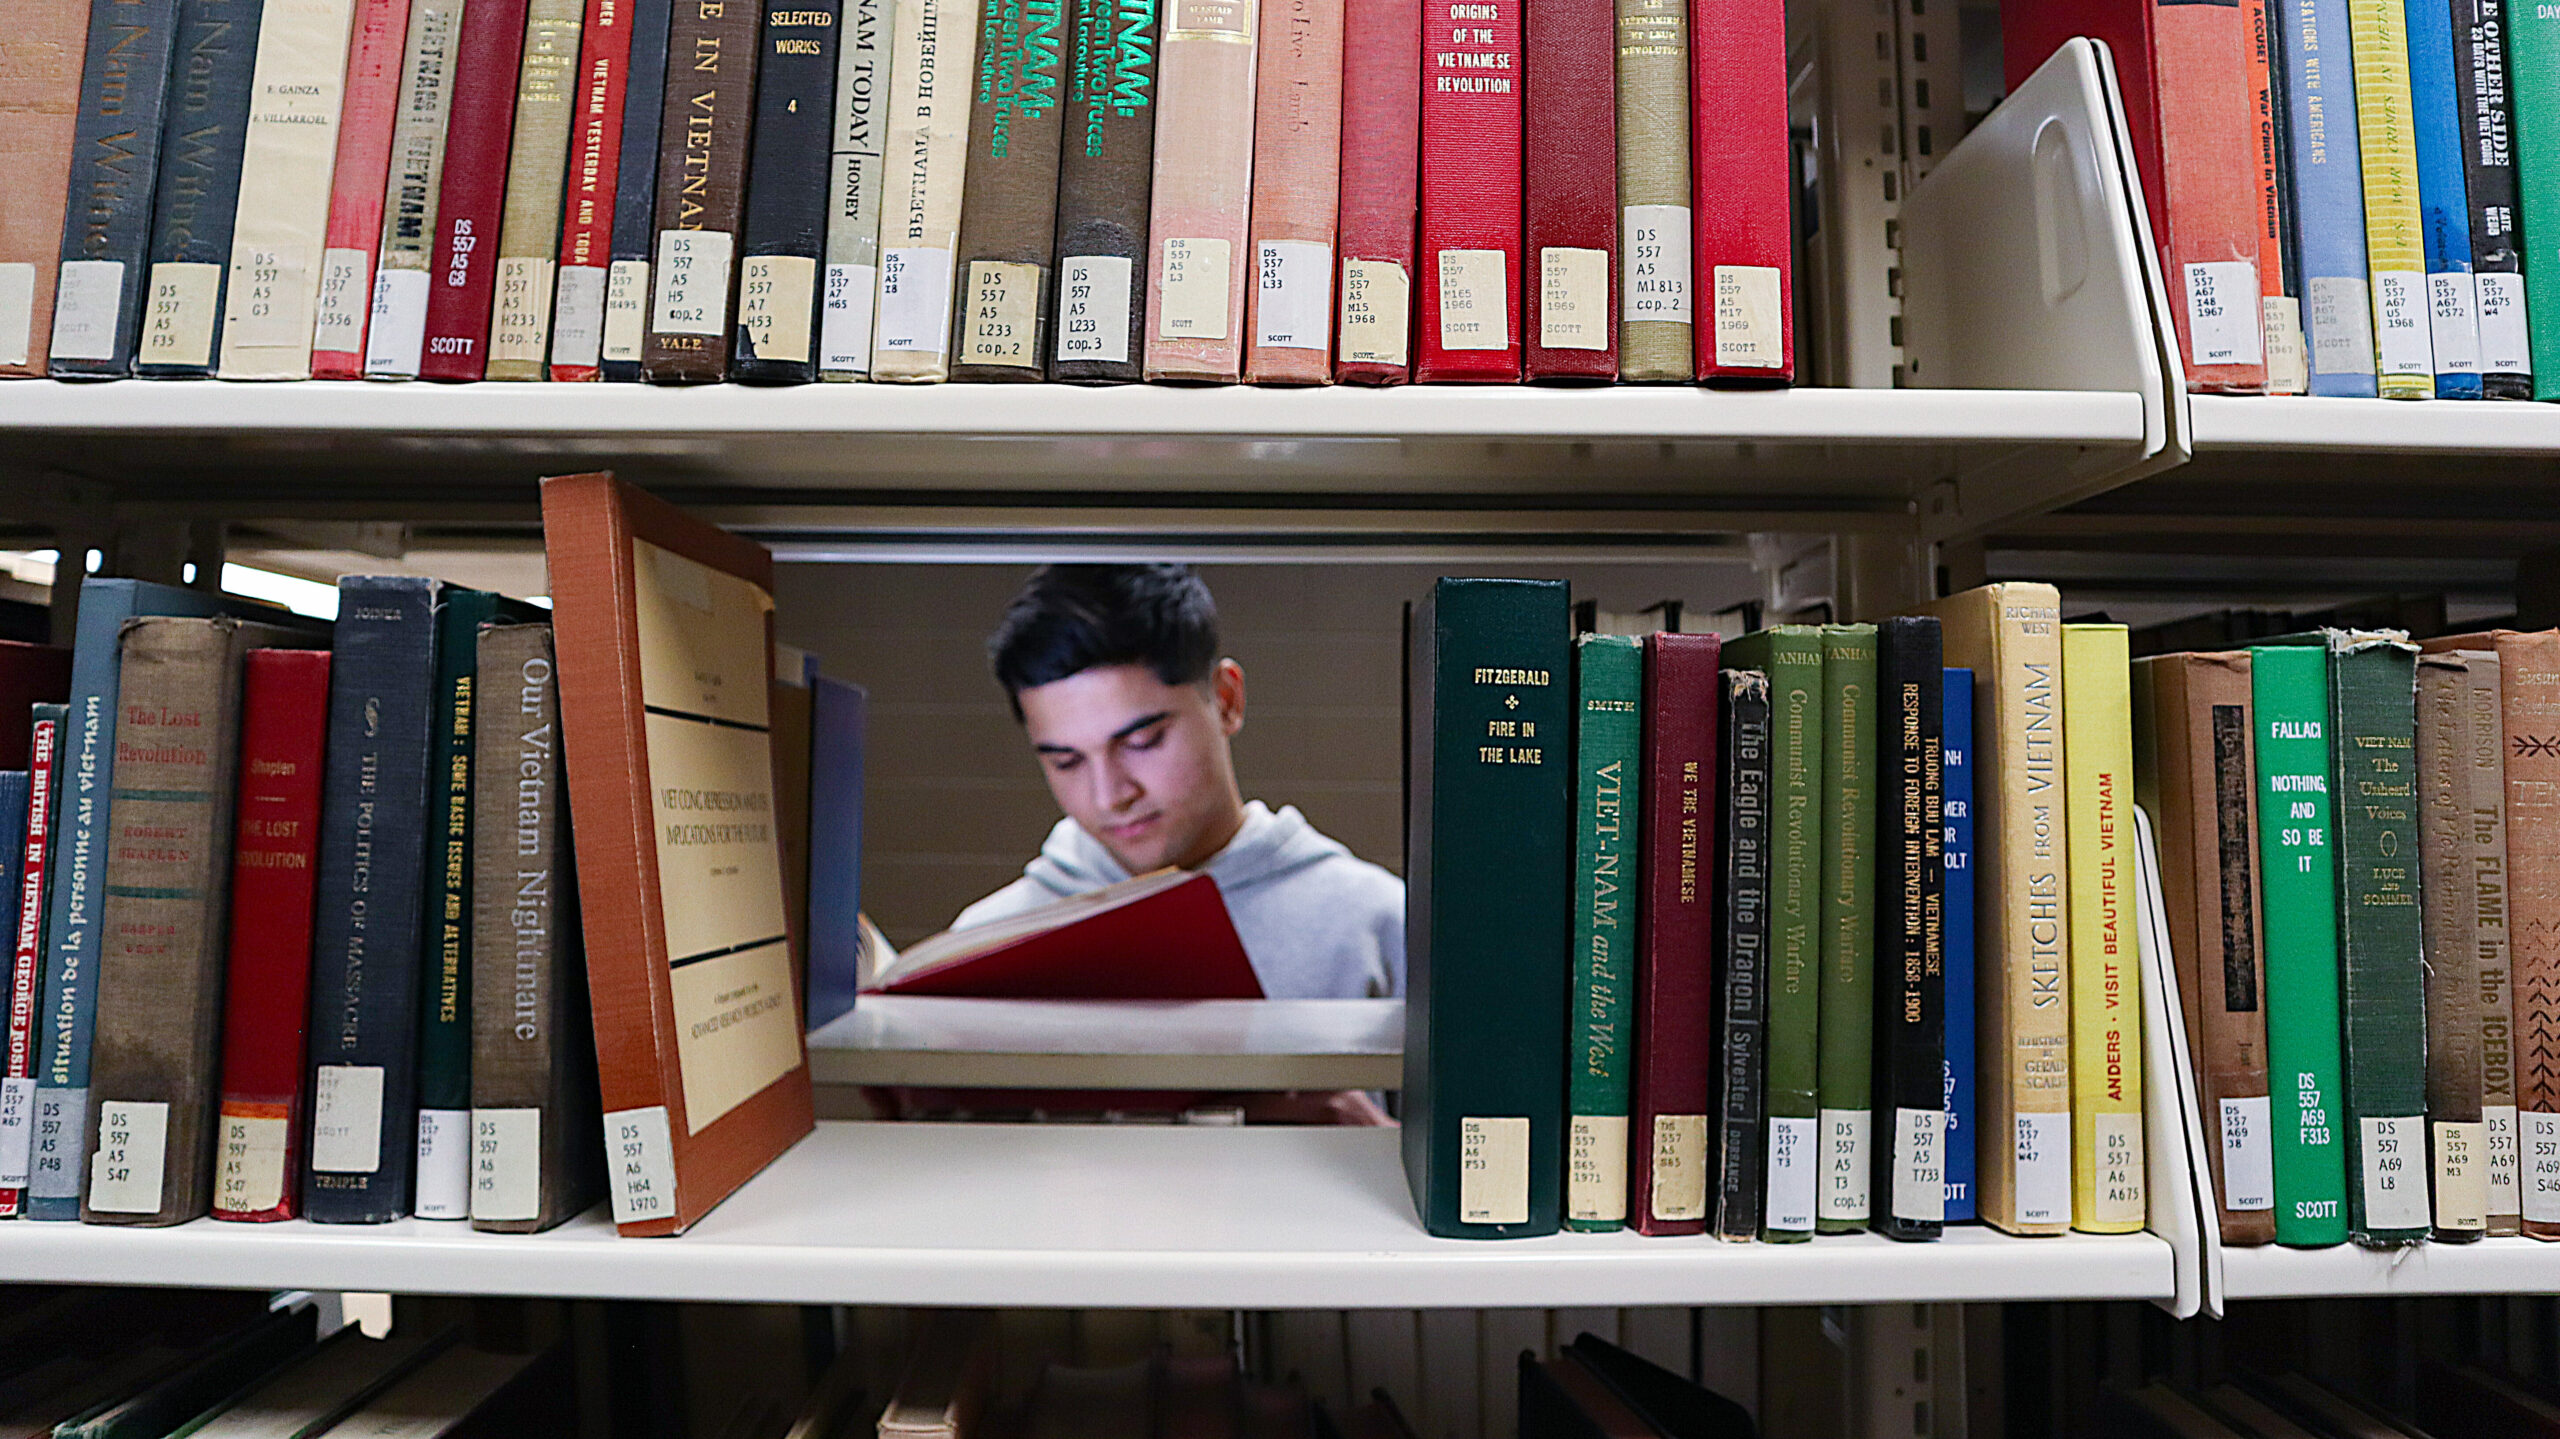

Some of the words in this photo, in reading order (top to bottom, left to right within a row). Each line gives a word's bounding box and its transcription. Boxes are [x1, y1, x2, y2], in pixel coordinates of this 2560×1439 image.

[770, 11, 832, 26] SELECTED
[1451, 5, 1498, 20] ORIGINS
[1453, 29, 1469, 44] OF
[1473, 29, 1494, 44] THE
[2472, 27, 2483, 40] 23
[776, 39, 821, 55] WORKS
[2473, 42, 2484, 68] DAYS
[1090, 46, 1116, 91] Two
[1437, 53, 1511, 69] VIETNAMESE
[2485, 20, 2504, 104] OTHER
[589, 58, 609, 114] VIETNAM
[1437, 77, 1511, 94] REVOLUTION
[2305, 59, 2322, 90] WITH
[2474, 69, 2486, 95] WITH
[279, 85, 319, 95] GAINZA
[2260, 89, 2269, 112] War
[787, 99, 797, 112] 4
[850, 61, 874, 148] TODAY
[2477, 97, 2488, 115] THE
[264, 114, 328, 125] VILLARROEL
[1086, 92, 1113, 157] Truces
[2308, 96, 2327, 165] AMERICANS
[2479, 116, 2491, 140] VIET
[2261, 116, 2272, 162] Crimes
[2491, 110, 2509, 167] SIDE
[581, 120, 603, 193] YESTERDAY
[2481, 141, 2493, 166] CONG
[2263, 168, 2273, 182] in
[845, 159, 862, 221] HONEY
[578, 197, 596, 226] AND
[2265, 186, 2276, 239] Vietnam
[2485, 206, 2498, 236] WEBB
[2500, 206, 2512, 231] KATE
[454, 219, 472, 234] DS
[1637, 229, 1656, 241] DS
[452, 237, 476, 252] 557
[1263, 249, 1277, 257] DS
[1637, 246, 1661, 258] 557
[451, 254, 468, 268] A5
[1264, 259, 1283, 267] 557
[1637, 264, 1655, 275] A5
[449, 270, 466, 287] G8
[830, 279, 848, 287] 557
[984, 273, 1002, 284] DS
[1263, 270, 1276, 278] A5
[1263, 280, 1282, 289] L33
[828, 289, 841, 297] A7
[981, 290, 1006, 301] 557
[1637, 281, 1682, 293] M1813
[828, 300, 847, 309] H65
[980, 307, 997, 318] A5
[1637, 300, 1667, 312] cop.
[1672, 298, 1680, 310] 2
[979, 325, 1011, 336] L233
[431, 338, 474, 355] SCOTT
[660, 338, 701, 350] YALE
[977, 343, 1006, 355] cop.
[1012, 343, 1020, 355] 2
[522, 658, 550, 719] Our
[1475, 668, 1549, 686] FITZGERALD
[127, 706, 156, 726] The
[161, 706, 201, 727] Lost
[454, 676, 471, 736] VIETNAM
[1587, 700, 1635, 712] SMITH
[1903, 683, 1919, 750] RESPONSE
[1489, 721, 1516, 737] FIRE
[1522, 722, 1535, 737] IN
[1741, 721, 1765, 760] The
[1789, 689, 1808, 787] Communist
[2024, 662, 2052, 795] VIETNAM
[2272, 721, 2321, 739] FALLACI
[36, 732, 49, 762] THE
[78, 695, 101, 791] viet-nam
[118, 743, 207, 766] Revolution
[1479, 747, 1503, 763] THE
[1510, 749, 1542, 764] LAKE
[1904, 757, 1919, 774] TO
[1925, 736, 1939, 791] TRUONG
[2373, 759, 2399, 773] The
[451, 755, 468, 792] SOME
[1684, 761, 1698, 783] WE
[518, 724, 550, 856] Vietnam
[2271, 775, 2327, 794] NOTHING,
[2360, 782, 2411, 796] Unheard
[30, 769, 47, 836] BRITISH
[1683, 789, 1698, 813] THE
[1734, 769, 1763, 829] Eagle
[1904, 778, 1920, 834] FOREIGN
[1925, 795, 1939, 823] BUU
[2290, 802, 2315, 819] AND
[77, 797, 92, 826] au
[449, 796, 467, 835] BASIC
[2099, 773, 2113, 854] VIETNAM
[2366, 806, 2407, 821] Voices
[2034, 806, 2050, 859] FROM
[2282, 829, 2300, 846] SO
[2308, 830, 2324, 846] BE
[2473, 806, 2499, 845] The
[29, 842, 43, 863] IN
[1593, 760, 1622, 929] VIET-NAM
[1925, 826, 1939, 857] LAM
[447, 841, 464, 888] ISSUES
[1681, 819, 1697, 903] VIETNAMESE
[1738, 840, 1758, 878] and
[1784, 795, 1807, 920] Revolutionary
[2298, 856, 2311, 872] IT
[69, 829, 90, 926] personne
[1904, 839, 1921, 936] INTERVENTION
[2475, 856, 2503, 929] FLAME
[445, 894, 461, 919] AND
[1736, 888, 1760, 924] the
[2102, 858, 2118, 955] BEAUTIFUL
[61, 931, 82, 953] la
[1925, 893, 1939, 976] VIETNAMESE
[2030, 872, 2060, 1011] SKETCHES
[511, 870, 548, 1041] Nightmare
[1591, 935, 1616, 981] and
[1786, 924, 1806, 994] Warfare
[2478, 940, 2504, 961] in
[61, 956, 79, 981] de
[440, 924, 460, 1023] ALTERNATIVES
[1730, 935, 1759, 1018] Dragon
[13, 955, 32, 1027] GEORGE
[1905, 951, 1921, 1023] 1858-1900
[2105, 963, 2119, 1010] VISIT
[2480, 971, 2506, 1005] the
[1591, 985, 1616, 1018] the
[52, 986, 75, 1085] situation
[1589, 1022, 1614, 1078] West
[2481, 1017, 2510, 1097] ICEBOX
[1731, 1031, 1751, 1120] Sylvester
[2106, 1030, 2121, 1101] ANDERS
[2298, 1073, 2315, 1089] DS
[2299, 1091, 2320, 1108] 557
[1915, 1116, 1932, 1128] DS
[2301, 1110, 2325, 1126] A69
[1914, 1133, 1933, 1145] 557
[2108, 1135, 2126, 1147] DS
[2300, 1128, 2330, 1145] F313
[1914, 1151, 1930, 1163] A5
[2108, 1152, 2131, 1164] 557
[1913, 1169, 1939, 1182] T733
[2108, 1170, 2126, 1183] A6
[2109, 1188, 2139, 1200] A675
[2296, 1201, 2337, 1219] SCOTT
